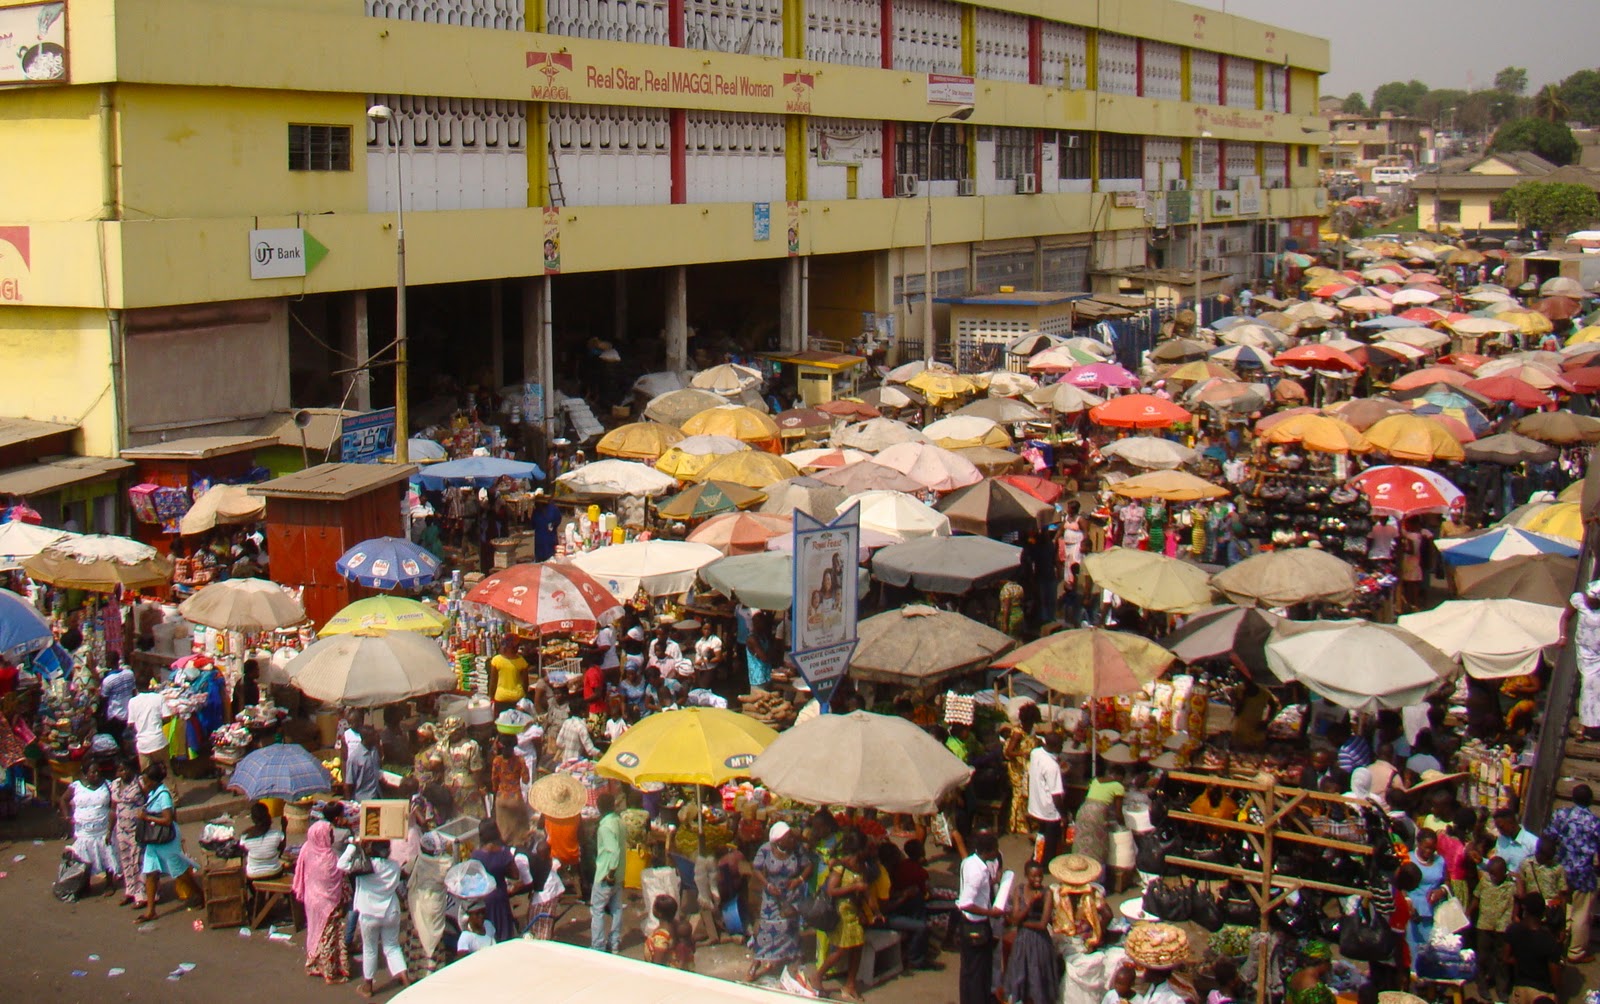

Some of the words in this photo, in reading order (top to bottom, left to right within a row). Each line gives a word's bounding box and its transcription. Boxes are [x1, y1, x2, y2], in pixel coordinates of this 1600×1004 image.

[586, 65, 614, 89] Real
[616, 67, 643, 92] Star,
[644, 69, 670, 92] Real
[672, 71, 713, 96] MAGGI,
[715, 74, 738, 96] Real
[740, 76, 774, 98] Woman
[531, 86, 569, 100] MAGGI
[277, 247, 301, 259] Bank
[809, 661, 820, 669] FOR
[820, 656, 841, 666] BETTER
[814, 666, 834, 676] GHANA
[731, 755, 753, 768] MTN
